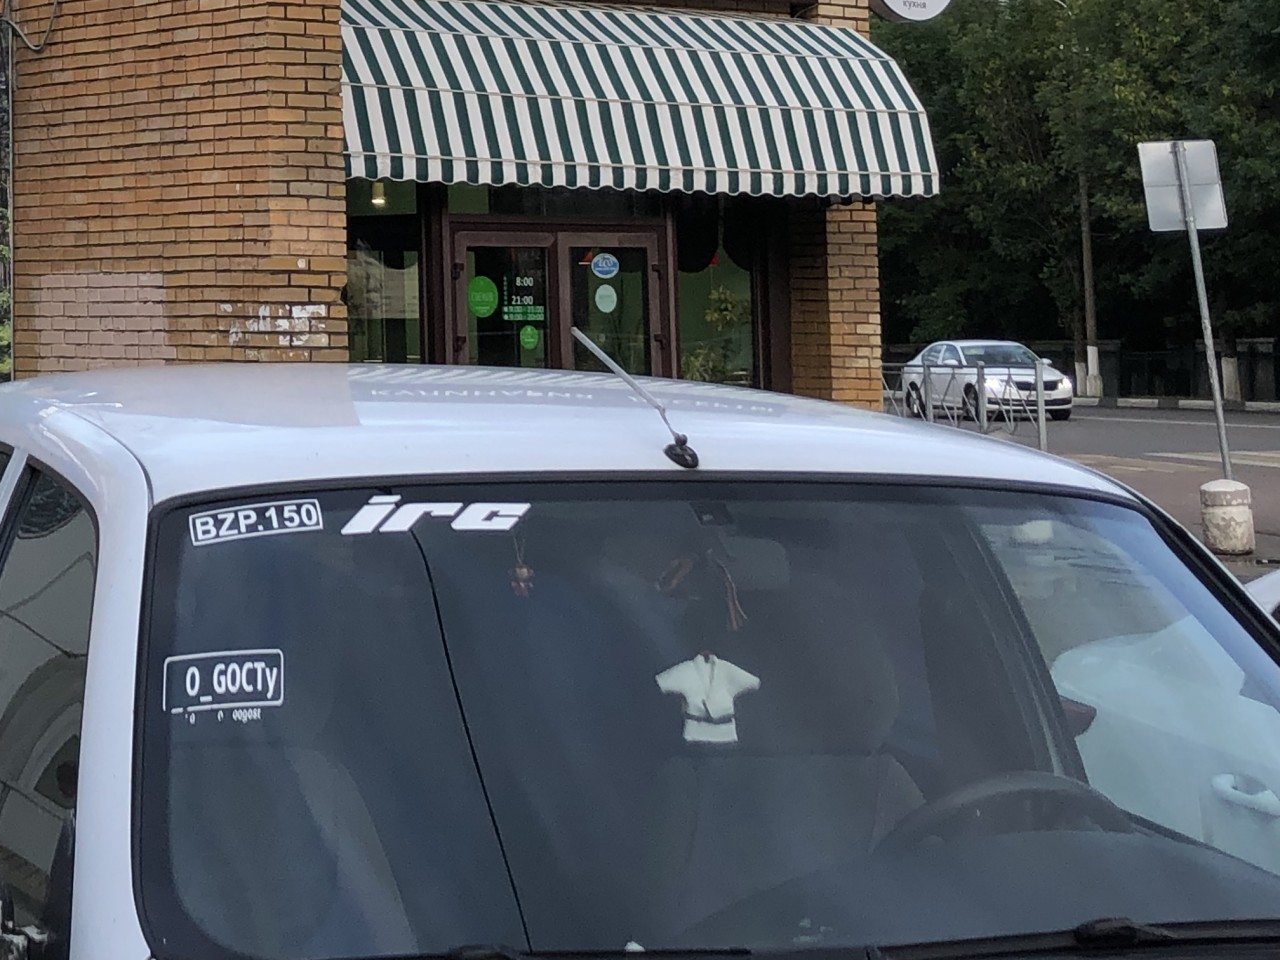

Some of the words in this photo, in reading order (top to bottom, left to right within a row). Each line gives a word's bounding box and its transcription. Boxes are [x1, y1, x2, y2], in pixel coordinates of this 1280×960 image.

[903, 1, 927, 10] кухня
[516, 277, 534, 286] 8:00
[512, 296, 534, 305] 21:00
[341, 494, 532, 536] irc
[194, 502, 318, 541] BZP.150
